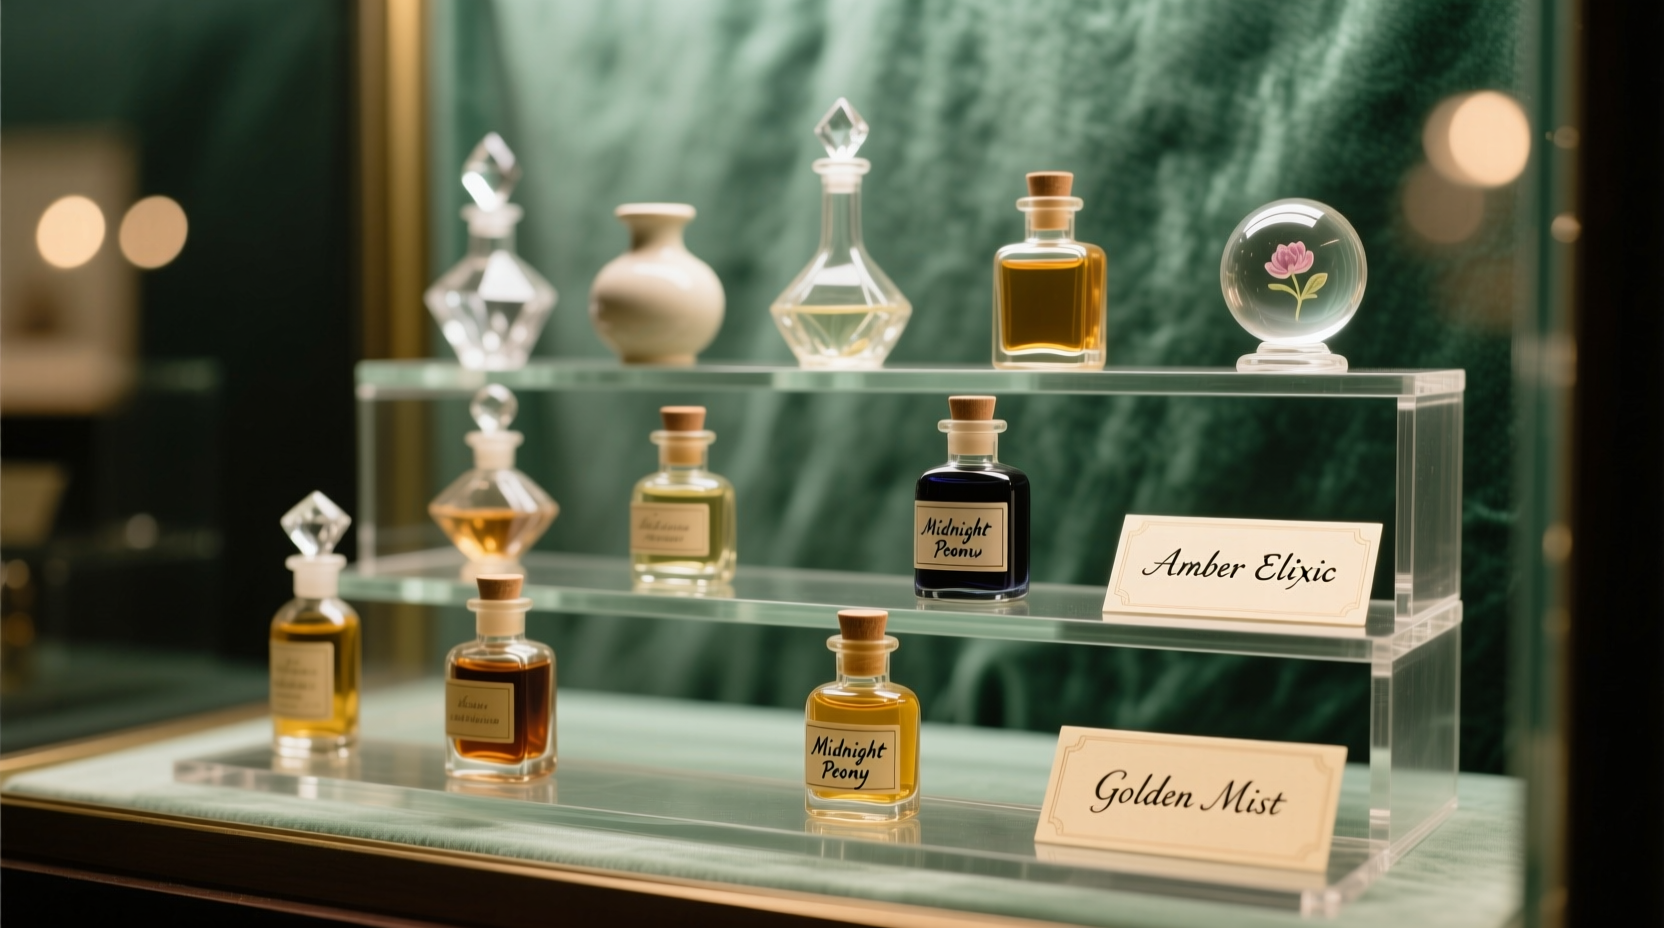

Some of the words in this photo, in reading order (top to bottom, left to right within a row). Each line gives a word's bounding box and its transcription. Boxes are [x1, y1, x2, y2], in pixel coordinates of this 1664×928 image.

[920, 516, 992, 546] Midnight
[1141, 547, 1246, 579] Amber
[1254, 551, 1338, 591] Elixic
[810, 735, 888, 767] Midnight
[821, 759, 870, 791] Peony
[1089, 768, 1195, 814] Golden
[1199, 779, 1288, 816] Mist
